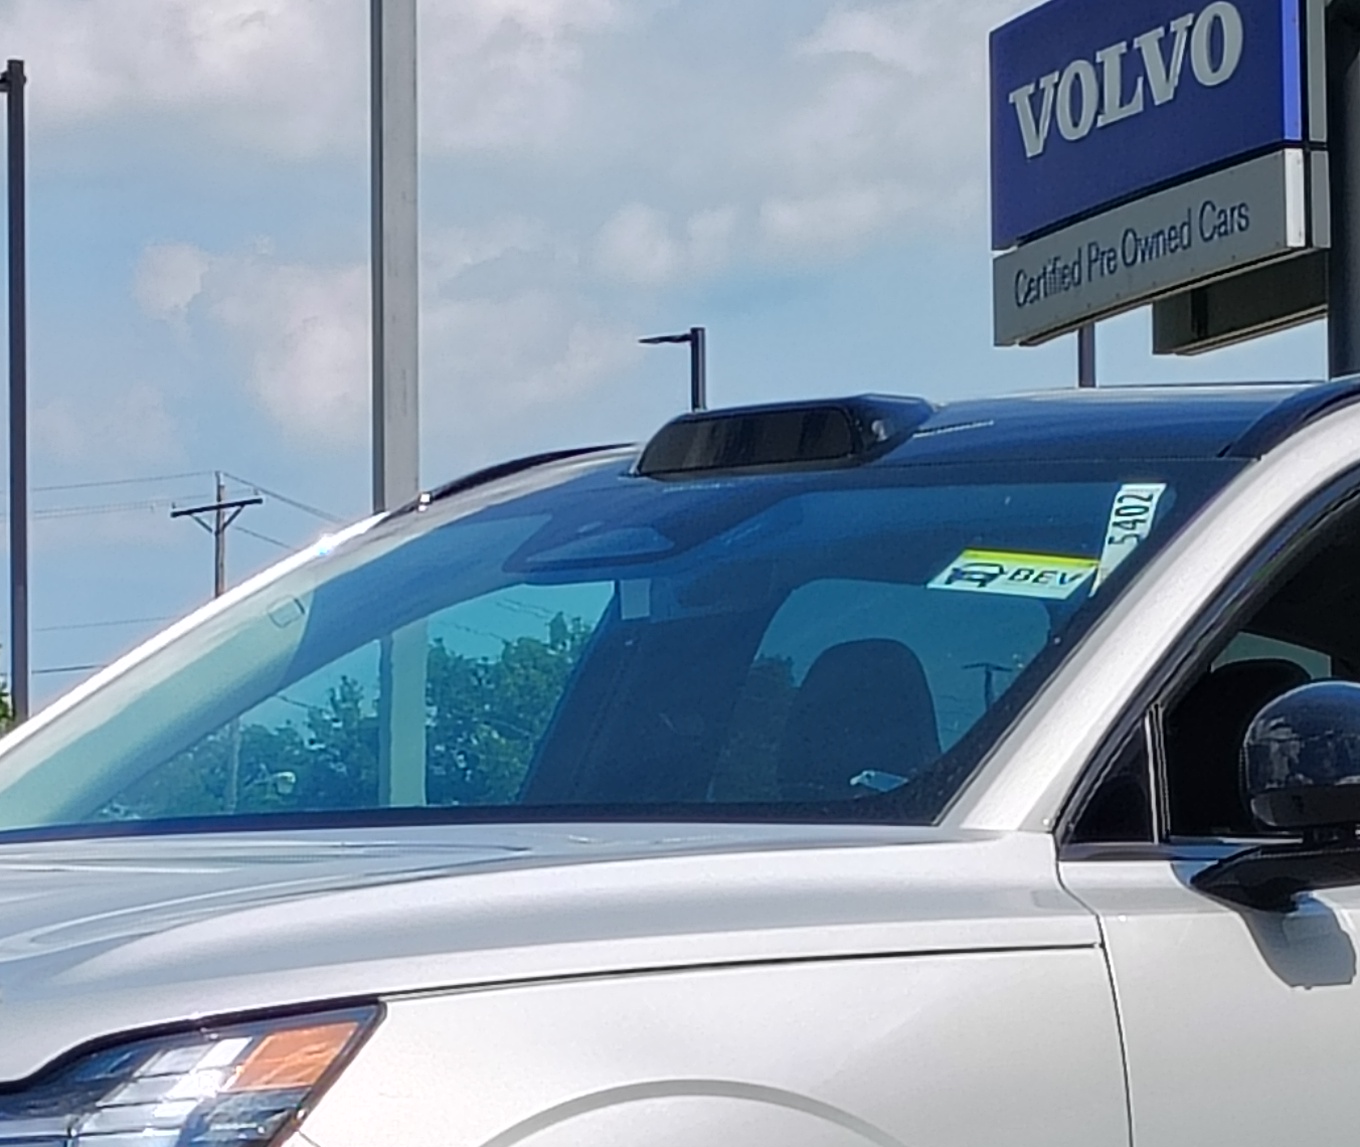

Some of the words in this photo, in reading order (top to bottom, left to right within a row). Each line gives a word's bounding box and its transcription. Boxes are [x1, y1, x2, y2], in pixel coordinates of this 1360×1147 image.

[1010, 0, 1243, 158] VOLVO
[1014, 248, 1083, 308] Certified
[1086, 242, 1117, 280] Pre
[1121, 209, 1193, 265] Owned
[1199, 199, 1250, 243] Cars
[1108, 493, 1153, 546] 5402
[1009, 568, 1081, 586] BEV
